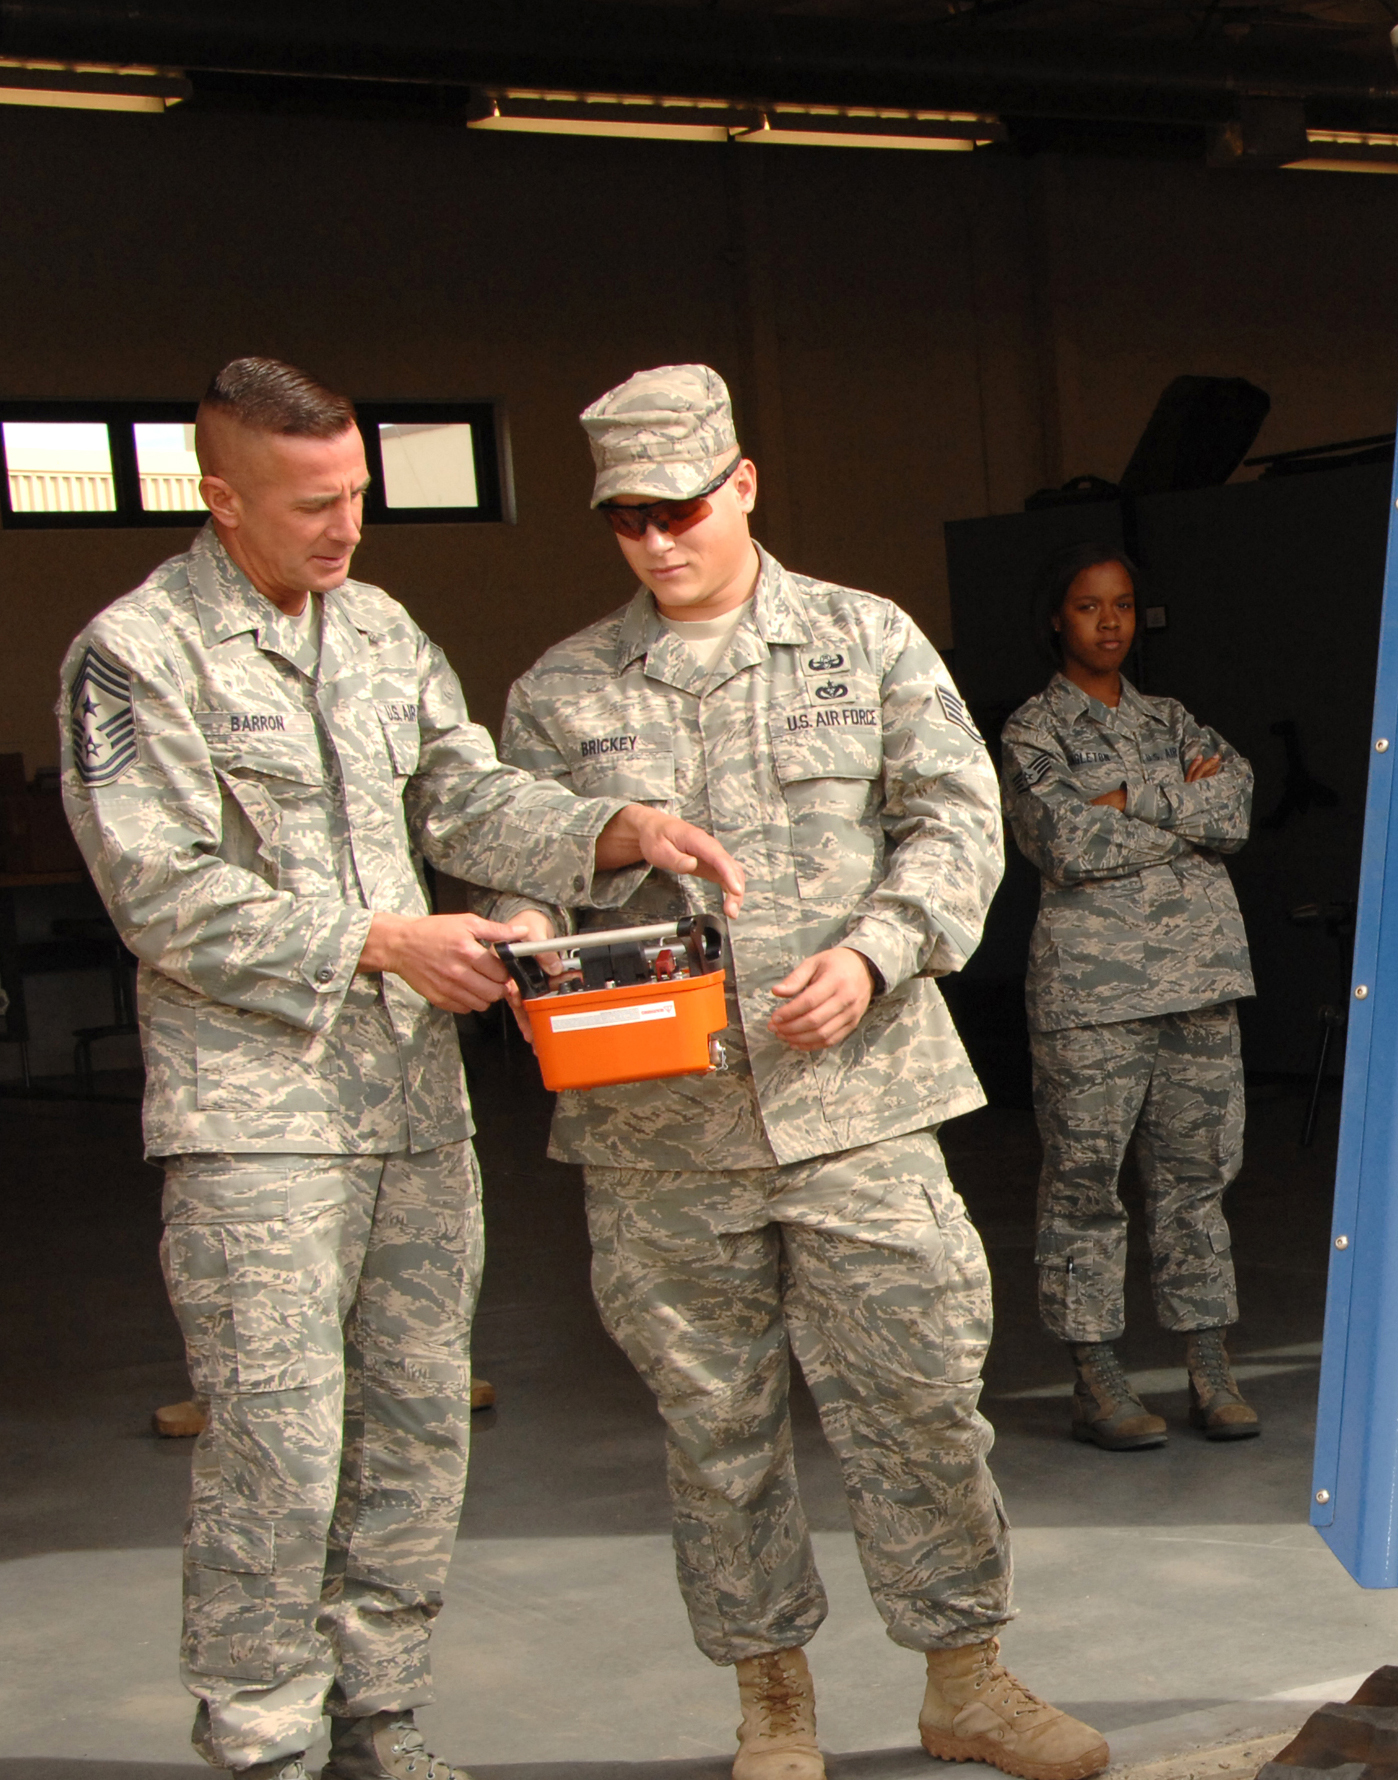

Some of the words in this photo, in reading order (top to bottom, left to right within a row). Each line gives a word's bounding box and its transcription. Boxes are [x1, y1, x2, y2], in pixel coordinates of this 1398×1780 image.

[231, 715, 285, 731] BARRON
[384, 704, 402, 722] U.S.
[402, 704, 417, 722] AIR
[787, 714, 813, 732] U.S.
[816, 711, 840, 727] AIR
[842, 709, 877, 726] FORCE
[581, 735, 636, 757] BRICKEY
